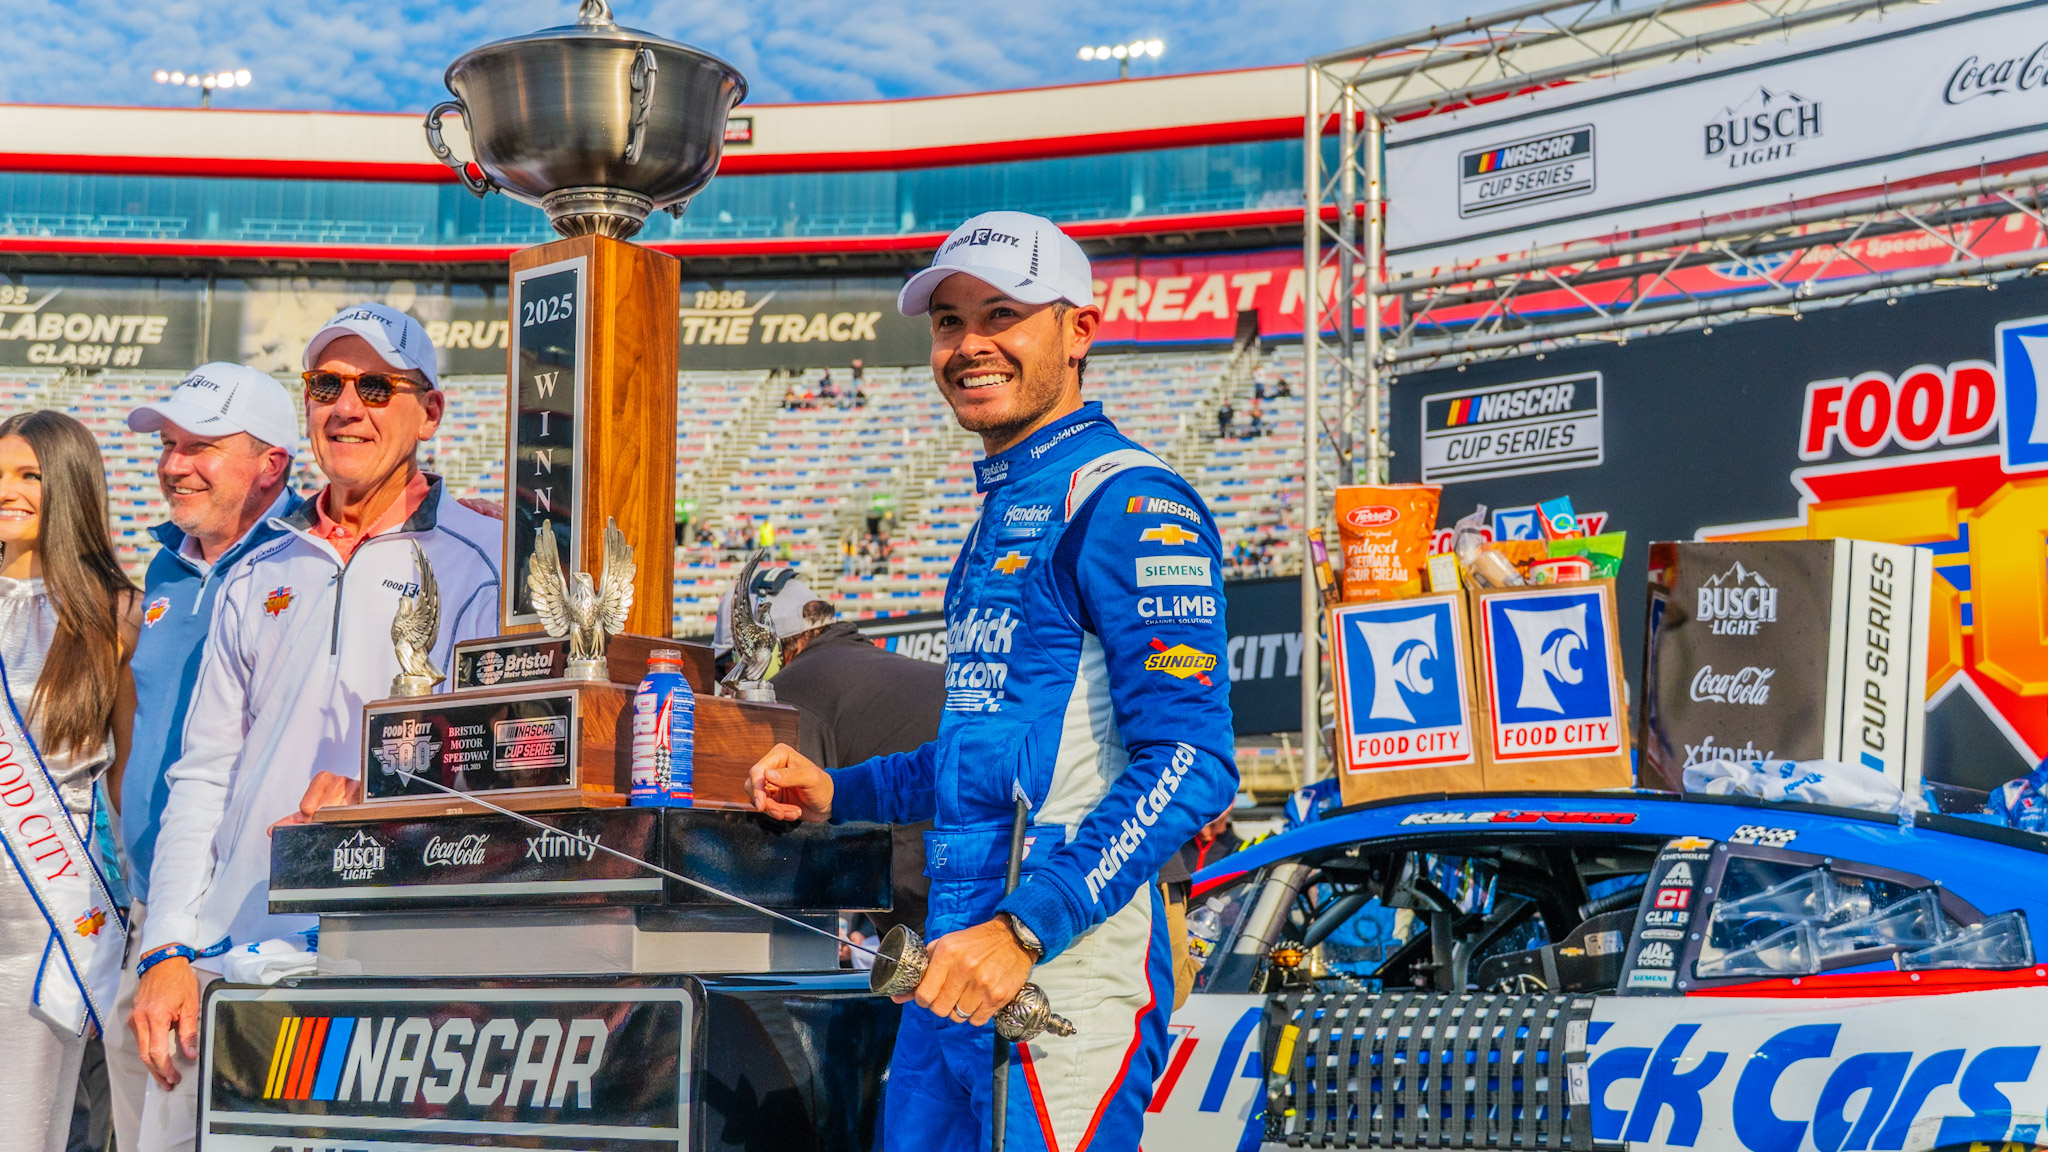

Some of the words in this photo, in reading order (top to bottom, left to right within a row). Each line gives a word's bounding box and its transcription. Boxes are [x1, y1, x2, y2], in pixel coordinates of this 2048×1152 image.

[1703, 100, 1823, 158] BUSCH
[1500, 135, 1574, 170] NASCAR
[1728, 142, 1797, 170] LIGHT
[1478, 172, 1513, 200] CUP
[1514, 164, 1575, 193] SERIES
[523, 292, 574, 328] 2025
[694, 289, 748, 310] 1996
[681, 316, 754, 345] THE
[760, 311, 883, 344] TRACK
[27, 342, 113, 366] CLASH
[113, 345, 144, 367] #1
[1477, 383, 1576, 422] NASCAR
[1806, 368, 1997, 454] FOOD
[1446, 434, 1491, 462] CUP
[1495, 424, 1576, 455] SERIES
[1003, 505, 1053, 526] Hendrick
[1147, 497, 1201, 524] NASCAR
[1145, 565, 1204, 577] SIEMENS
[1371, 568, 1409, 582] CREAM
[382, 579, 403, 591] FOOD
[1137, 595, 1217, 618] CLIMB
[1697, 587, 1778, 622] BUSCH
[1865, 552, 1894, 678] SERIES
[1712, 620, 1758, 635] LIGHT
[504, 649, 555, 672] Bristol
[1147, 655, 1216, 669] SUNOCO
[503, 670, 520, 679] Motor
[521, 667, 552, 678] Speedway
[1861, 679, 1887, 752] CUP
[383, 725, 403, 738] FOOD
[415, 722, 432, 735] CITY
[448, 724, 486, 738] BRISTOL
[518, 723, 556, 738] NASCAR
[1503, 727, 1558, 748] FOOD
[1563, 721, 1610, 744] CITY
[450, 738, 483, 750] MOTOR
[504, 744, 524, 758] CUP
[523, 742, 557, 757] SERIES
[1358, 735, 1410, 758] FOOD
[1416, 730, 1461, 753] CITY
[381, 740, 431, 776] 500
[443, 750, 490, 764] SPEEDWAY
[19, 814, 80, 882] CITY
[423, 834, 490, 867] Coca-Cola
[525, 829, 602, 863] xfinity
[332, 847, 385, 871] BUSCH
[1084, 817, 1147, 905] ndrick
[342, 869, 372, 880] LIGHT
[1660, 878, 1694, 886] AXALTA
[1645, 911, 1690, 923] CLIMB
[1637, 958, 1673, 966] TOOLS
[1639, 942, 1675, 959] MAC
[335, 1017, 609, 1108] NASCAR
